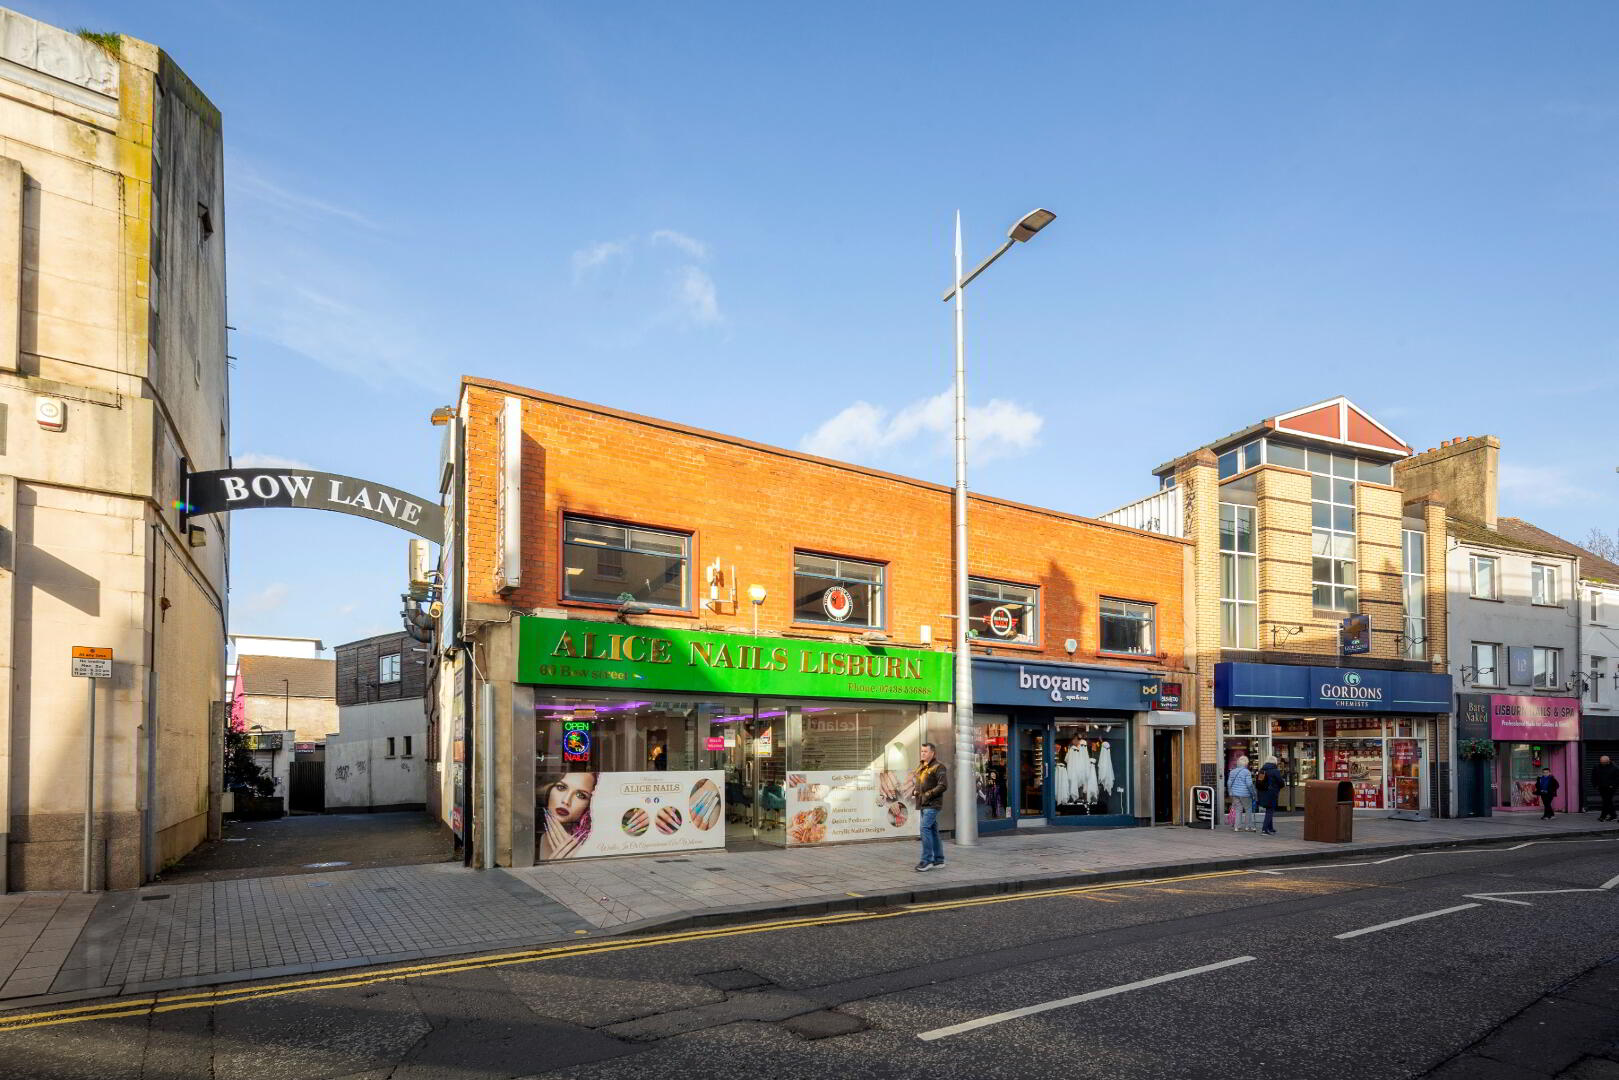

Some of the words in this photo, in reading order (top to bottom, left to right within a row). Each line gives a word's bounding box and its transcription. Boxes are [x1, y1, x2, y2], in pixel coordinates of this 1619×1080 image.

[220, 475, 315, 501] BOW
[328, 479, 423, 526] LANE
[551, 630, 673, 664] ALICE
[688, 641, 789, 672] NAILS
[800, 650, 923, 680] LISBURN
[1020, 665, 1090, 701] brogans
[1321, 683, 1383, 700] GORDONS
[1335, 700, 1369, 708] CHEMISTS
[564, 722, 589, 731] OPEN
[564, 752, 589, 761] NAILS
[624, 785, 652, 793] ALICE
[653, 784, 680, 793] NAILS
